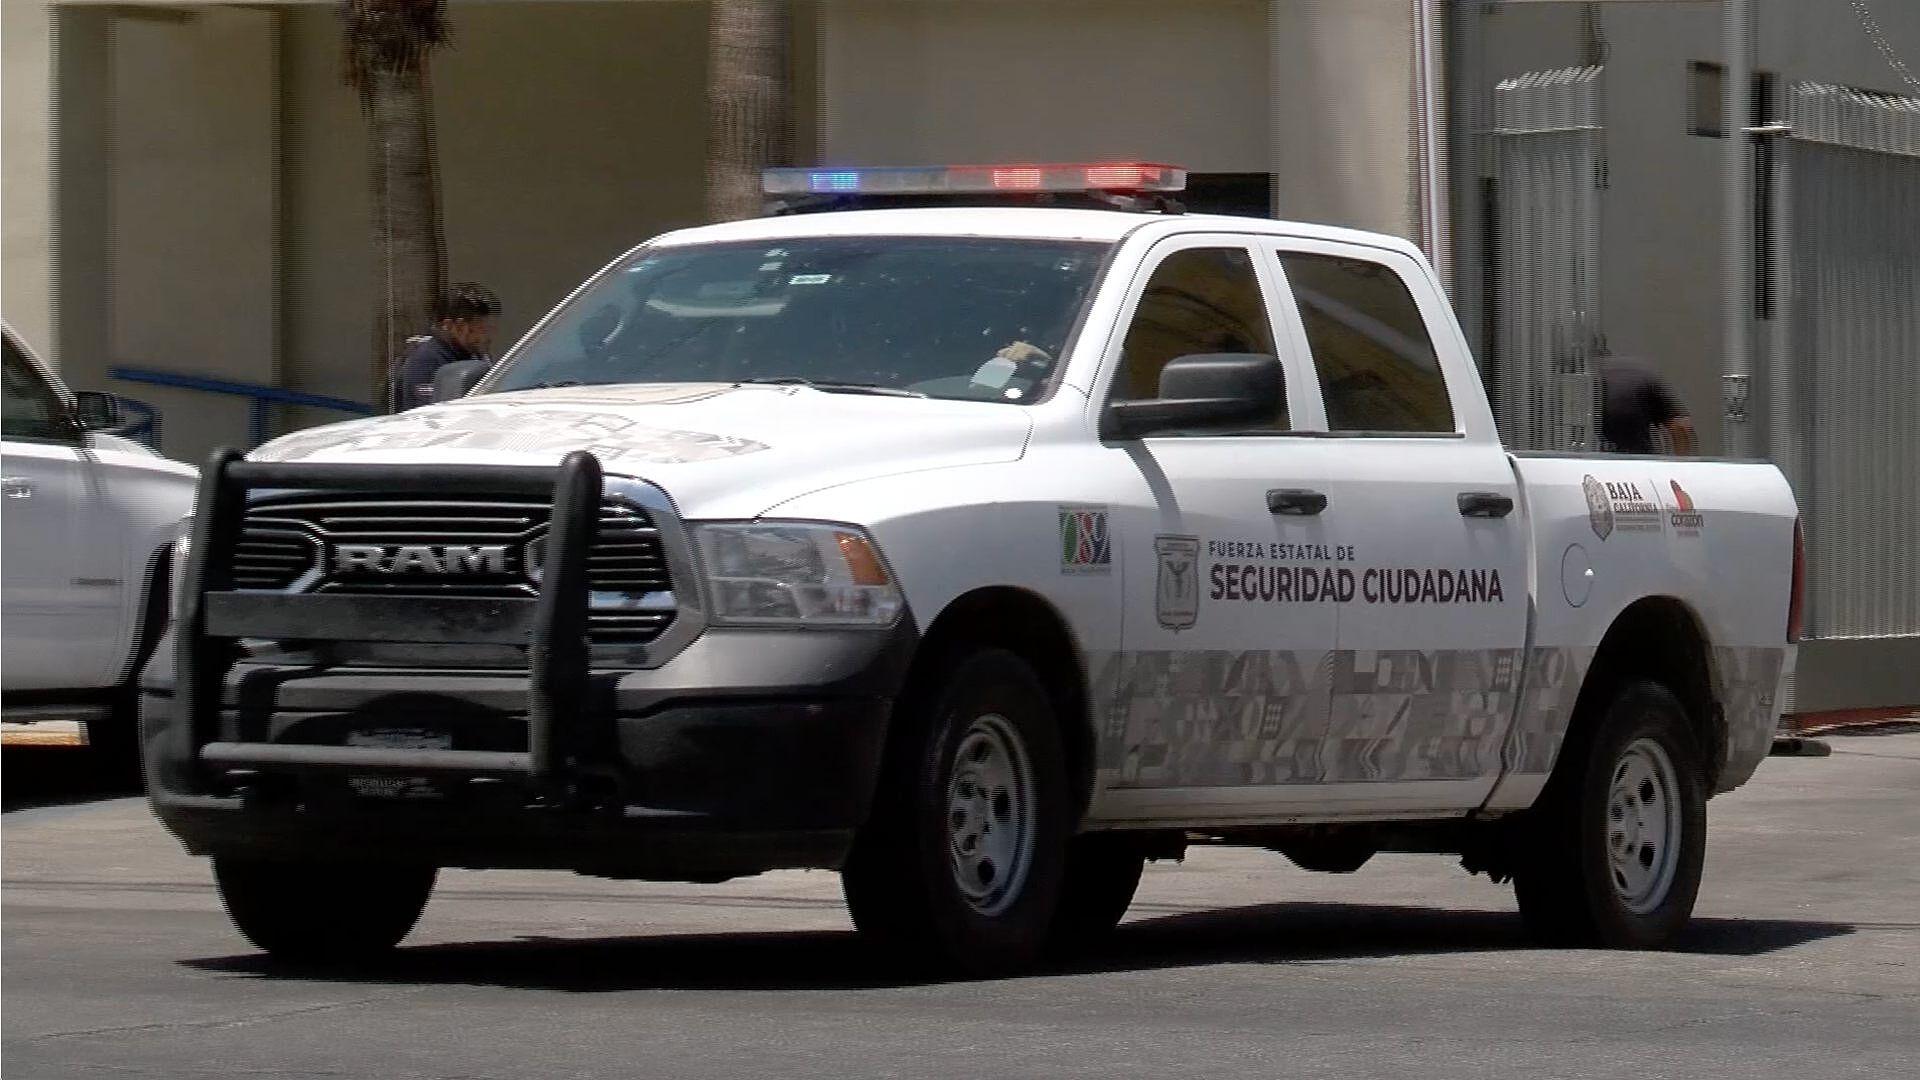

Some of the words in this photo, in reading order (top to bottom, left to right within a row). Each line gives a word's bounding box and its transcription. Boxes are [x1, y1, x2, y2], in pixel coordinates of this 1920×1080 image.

[1606, 482, 1642, 501] BAJA
[1614, 502, 1658, 513] CALIFORNIA
[337, 545, 506, 574] RAM
[1208, 541, 1264, 558] FUERZA
[1271, 543, 1331, 560] ESTATAL
[1337, 545, 1355, 561] DE
[1210, 564, 1355, 602] SEGURIDAD
[1362, 568, 1504, 603] CIUDADANA
